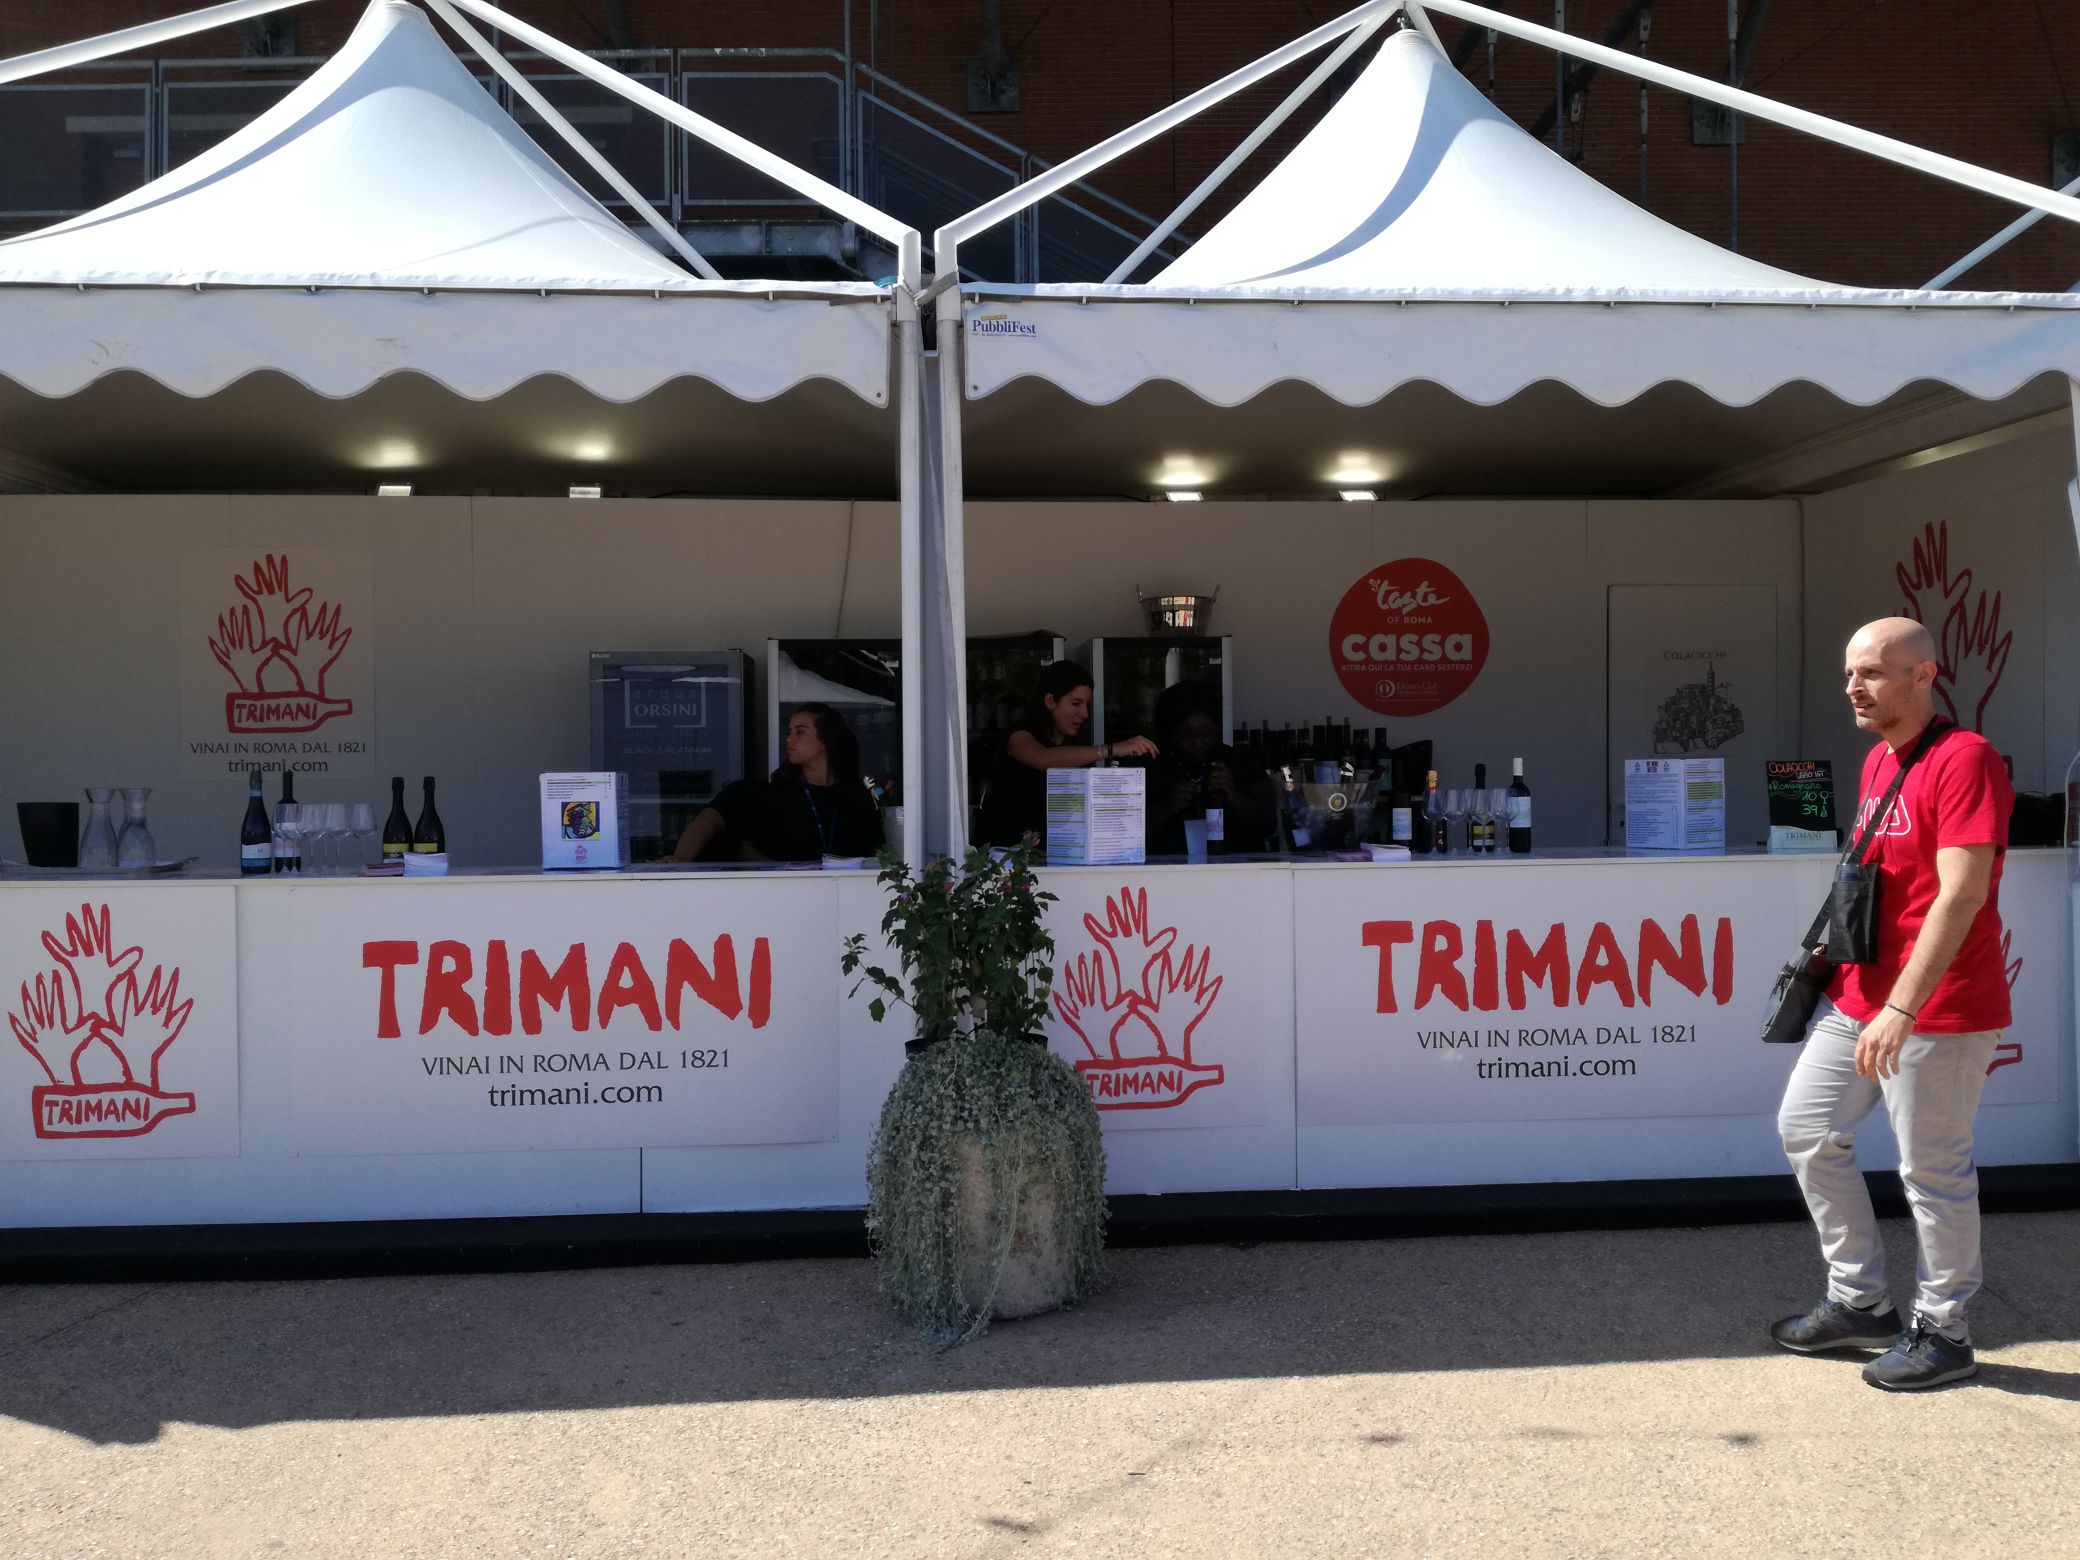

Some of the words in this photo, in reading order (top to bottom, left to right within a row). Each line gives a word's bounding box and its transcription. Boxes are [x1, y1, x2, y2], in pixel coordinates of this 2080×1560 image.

[972, 319, 1037, 333] PubbliFest
[1376, 579, 1451, 616] taste
[1387, 616, 1401, 624] OF
[1403, 616, 1433, 624] ROMA
[1341, 633, 1473, 662] cassa
[1368, 664, 1383, 672] QUI
[1413, 663, 1436, 671] CARD
[633, 688, 697, 699] acqua
[235, 702, 318, 723] TRIMANI
[634, 703, 697, 717] ORSINI
[190, 743, 229, 754] VINAI
[234, 743, 249, 754] IN
[253, 742, 298, 754] ROMA
[302, 742, 332, 753] DAL
[337, 742, 367, 753] 1821
[228, 759, 328, 772] trimani.com
[1802, 790, 1817, 801] 10
[1801, 804, 1817, 817] 39
[1362, 913, 1734, 1014] TRIMANI
[362, 933, 772, 1039] TRIMANI
[1416, 1030, 1479, 1049] VINAI
[1487, 1029, 1510, 1047] IN
[1518, 1028, 1588, 1047] ROMA
[1596, 1026, 1642, 1045] DAL
[1651, 1024, 1697, 1043] 1821
[421, 1056, 491, 1076] VINAI
[499, 1055, 525, 1074] IN
[533, 1053, 611, 1074] ROMA
[619, 1051, 669, 1071] DAL
[680, 1049, 730, 1069] 1821
[1477, 1055, 1637, 1079] trimani.com
[488, 1082, 663, 1107] trimani.com
[1086, 1070, 1183, 1098] TRIMANI
[45, 1097, 150, 1125] TRIMANI
